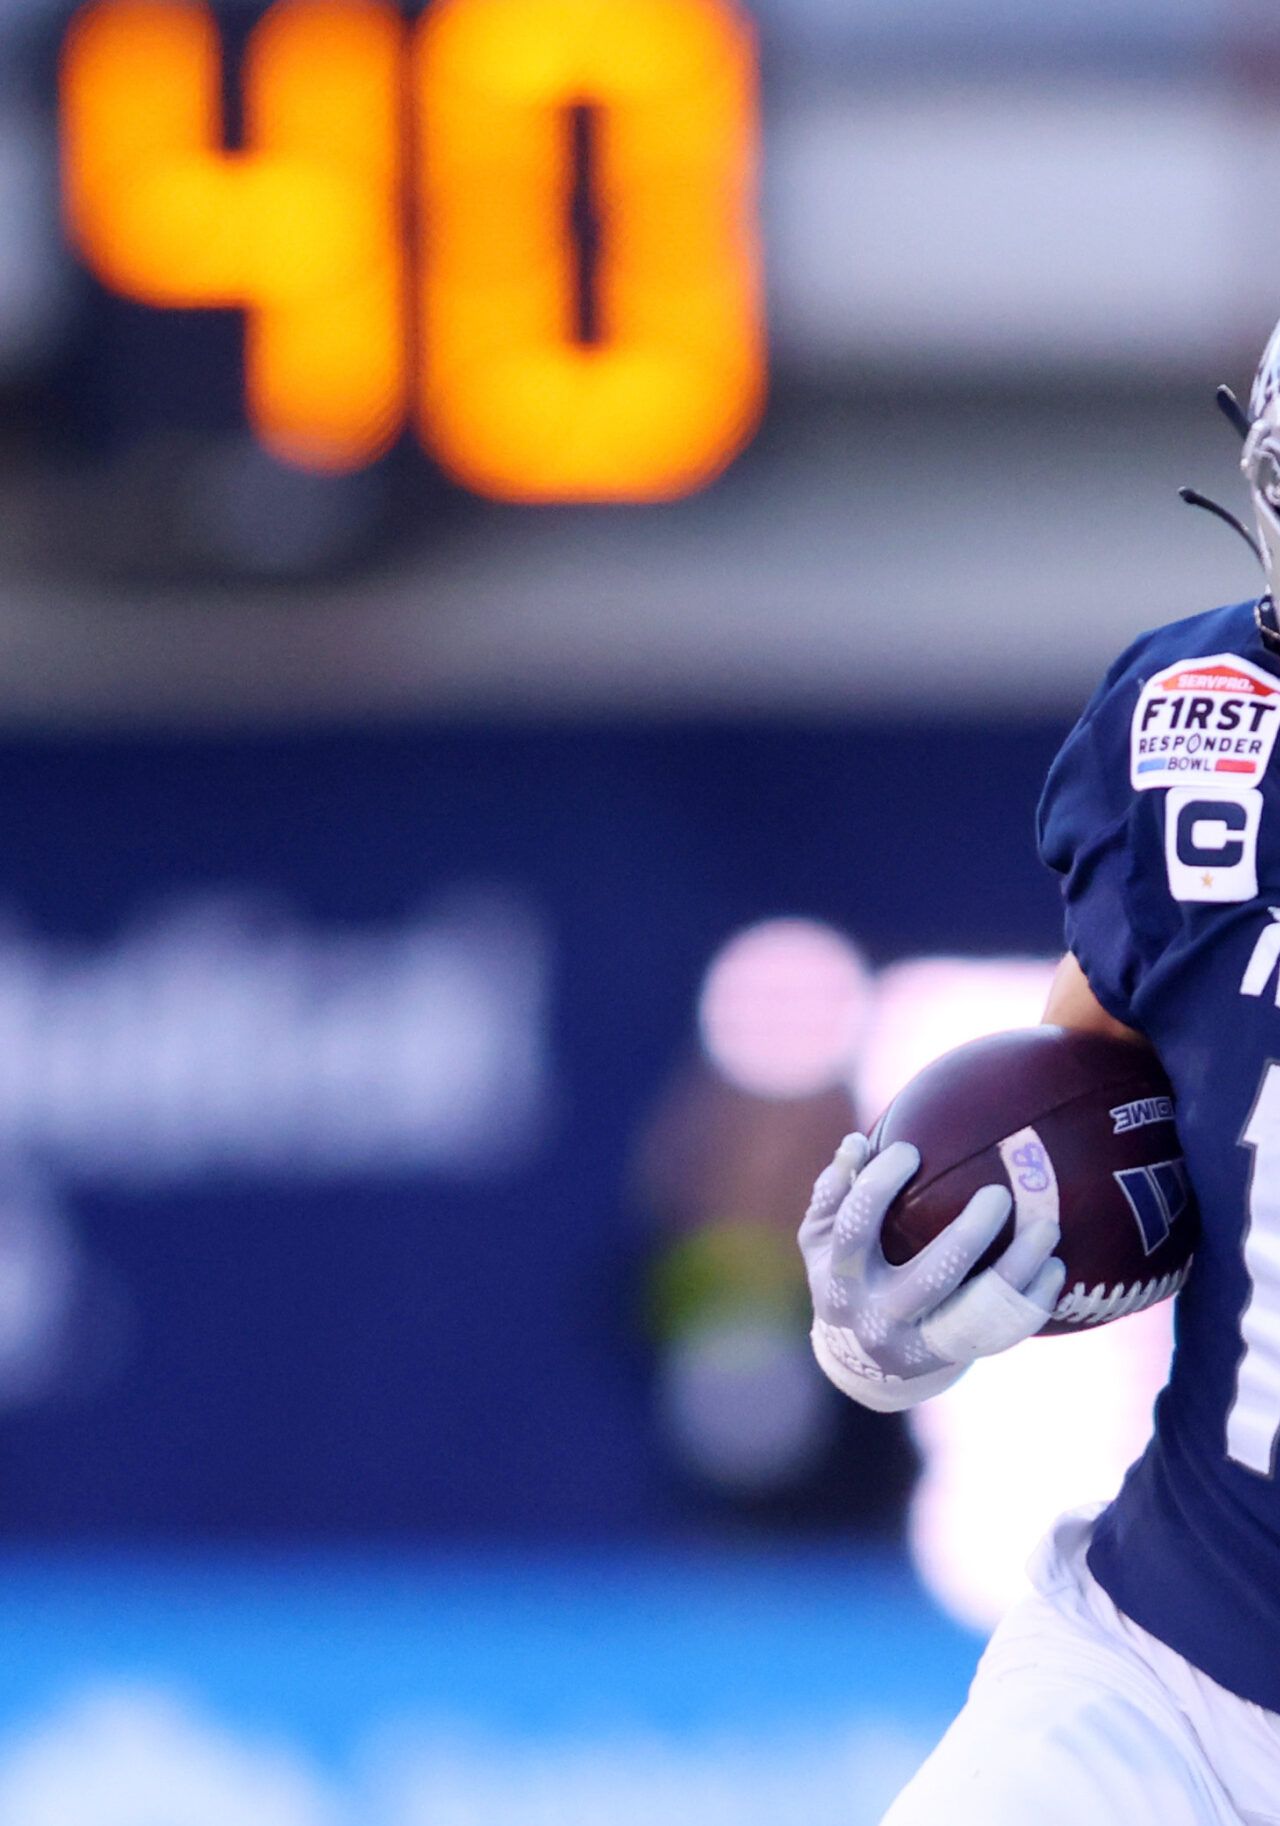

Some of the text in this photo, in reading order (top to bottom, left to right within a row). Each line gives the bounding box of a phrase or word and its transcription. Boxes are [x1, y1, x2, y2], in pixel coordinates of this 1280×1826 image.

[58, 0, 767, 502] 40
[1141, 696, 1277, 732] F1RST
[1138, 733, 1263, 755] RESPONDER
[1167, 757, 1211, 771] BOWL
[1176, 800, 1248, 868] C
